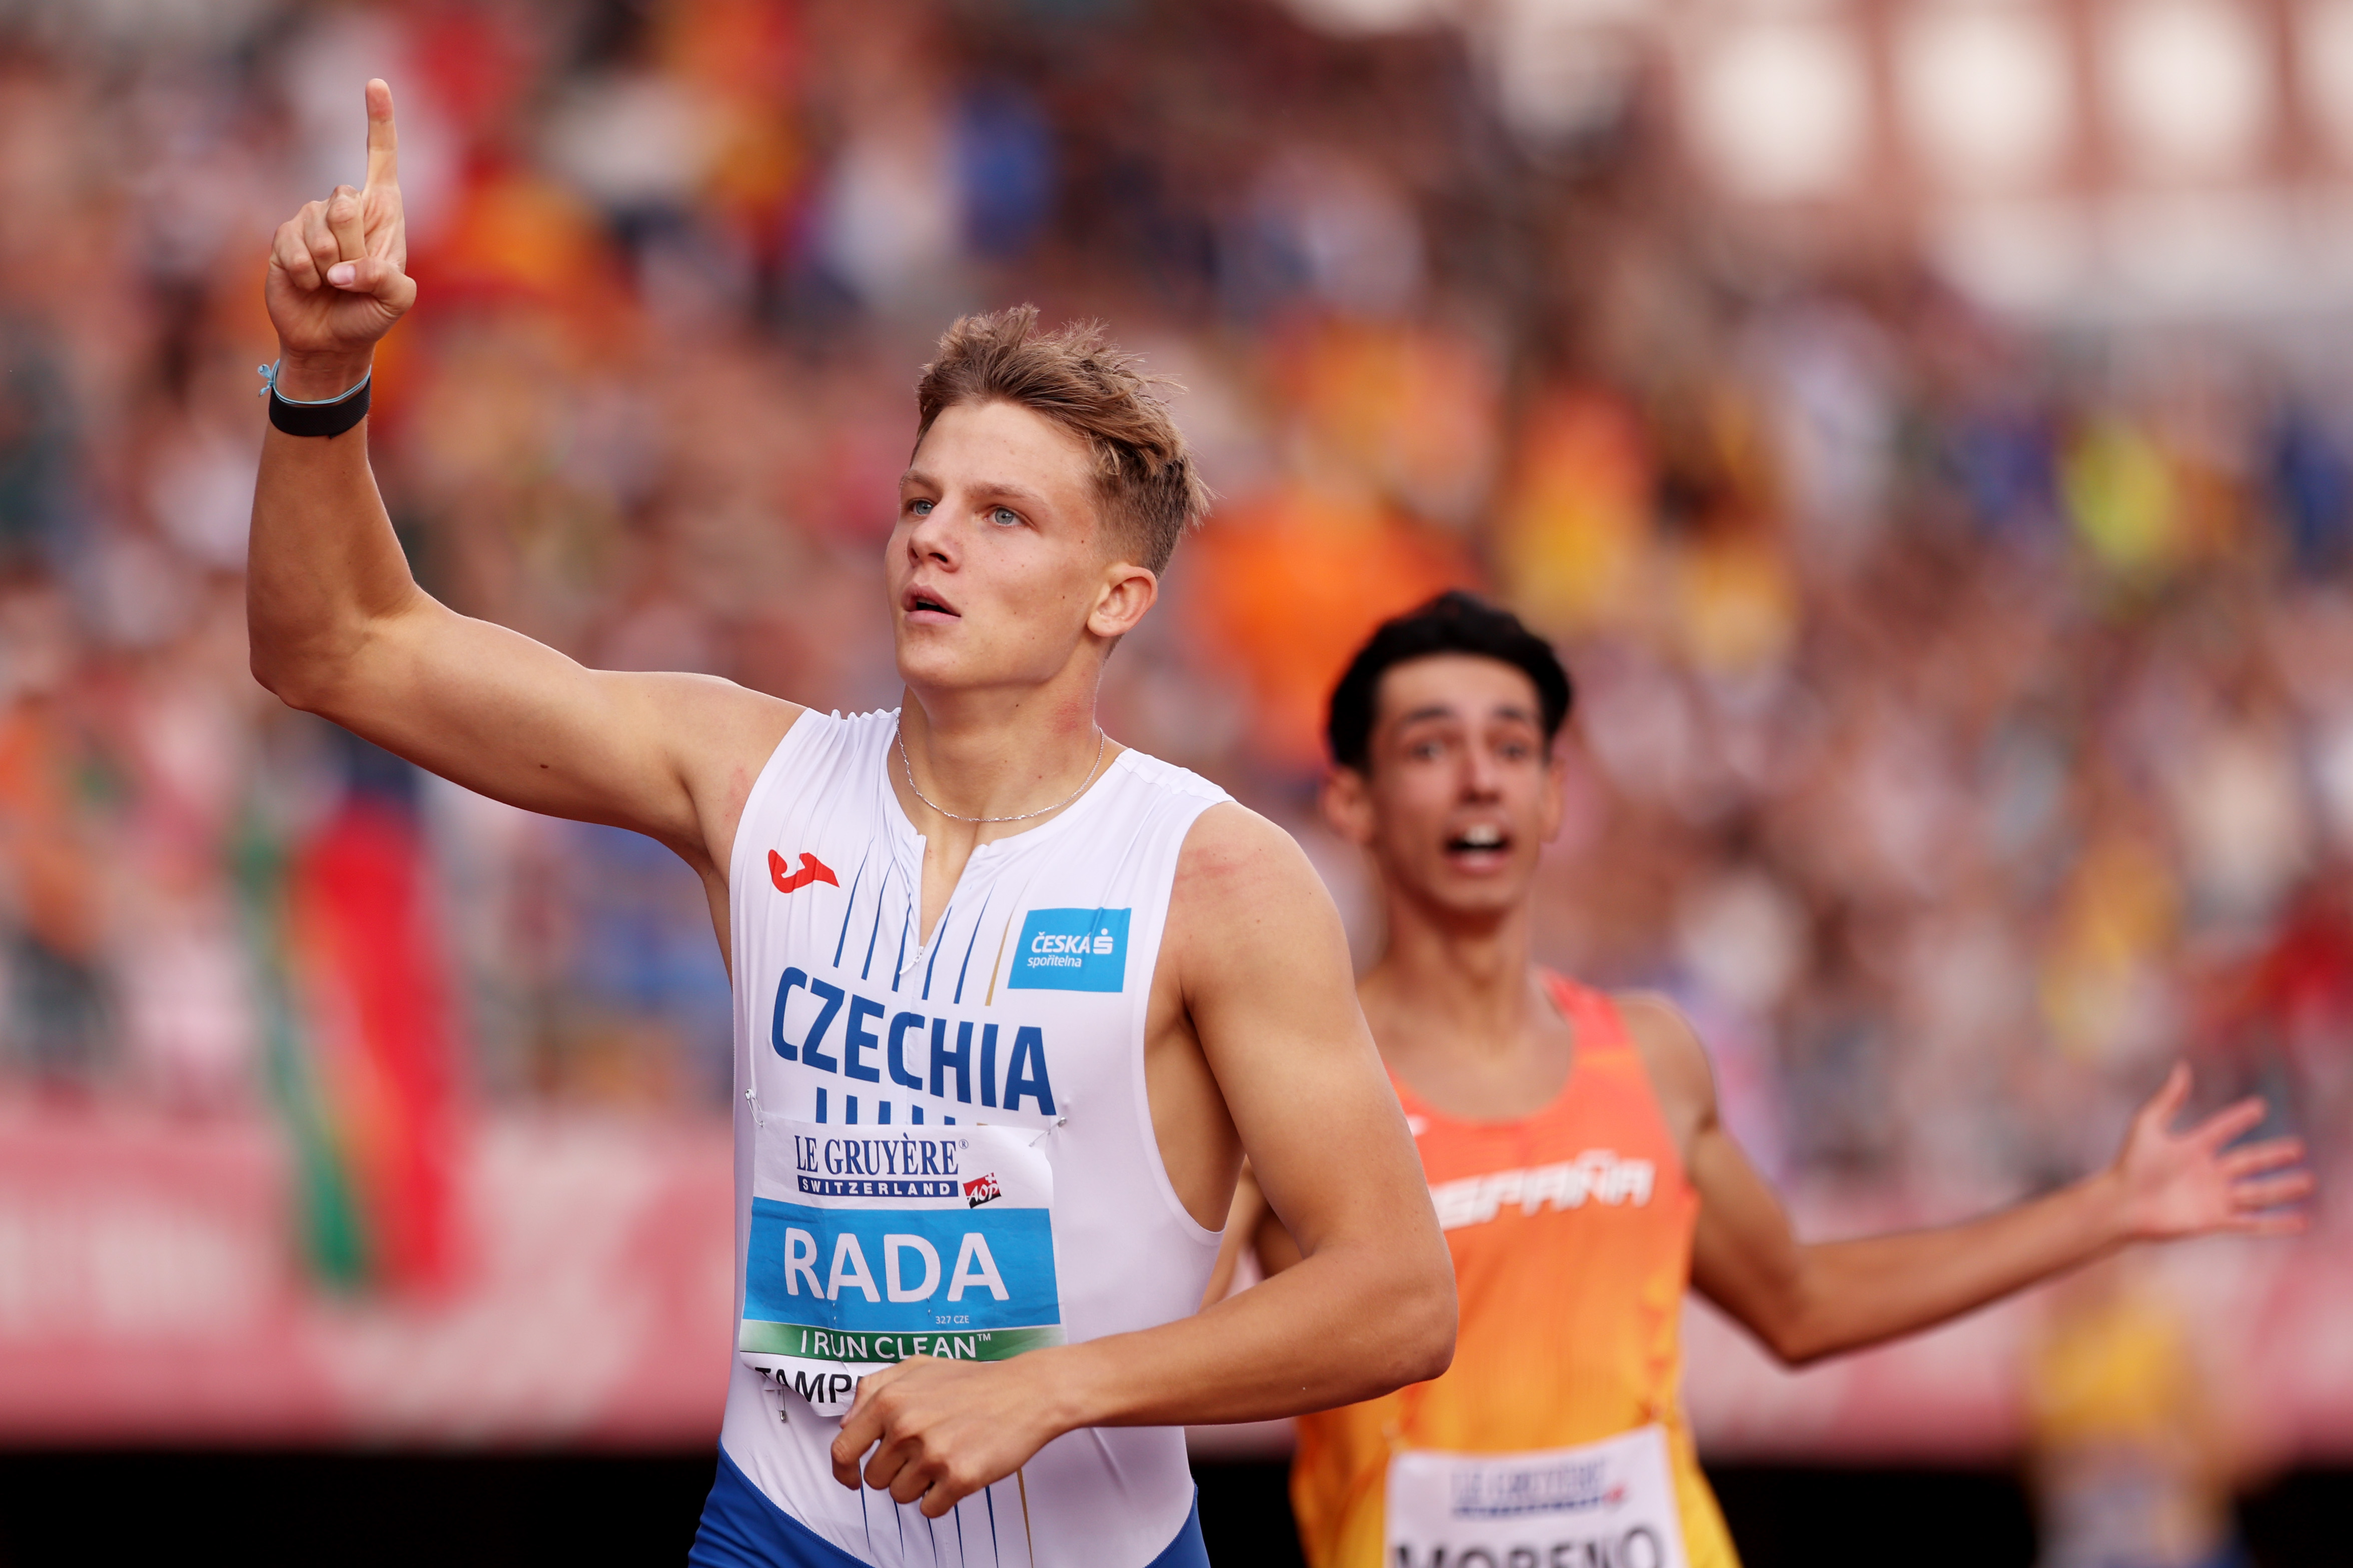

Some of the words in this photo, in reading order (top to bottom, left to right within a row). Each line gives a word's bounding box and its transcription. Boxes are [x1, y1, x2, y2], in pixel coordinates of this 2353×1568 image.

[1031, 931, 1091, 954] ČESKÁ
[1027, 954, 1082, 968] spořitelna
[771, 966, 1056, 1116] CZECHIA
[795, 1135, 819, 1172] LE
[803, 1178, 951, 1195] SWITZERLAND
[967, 1182, 999, 1203] AOP
[784, 1227, 1010, 1303] RADA
[936, 1315, 951, 1324] 327
[954, 1315, 970, 1324] CZE
[801, 1330, 807, 1353] I
[814, 1331, 868, 1358] RUN
